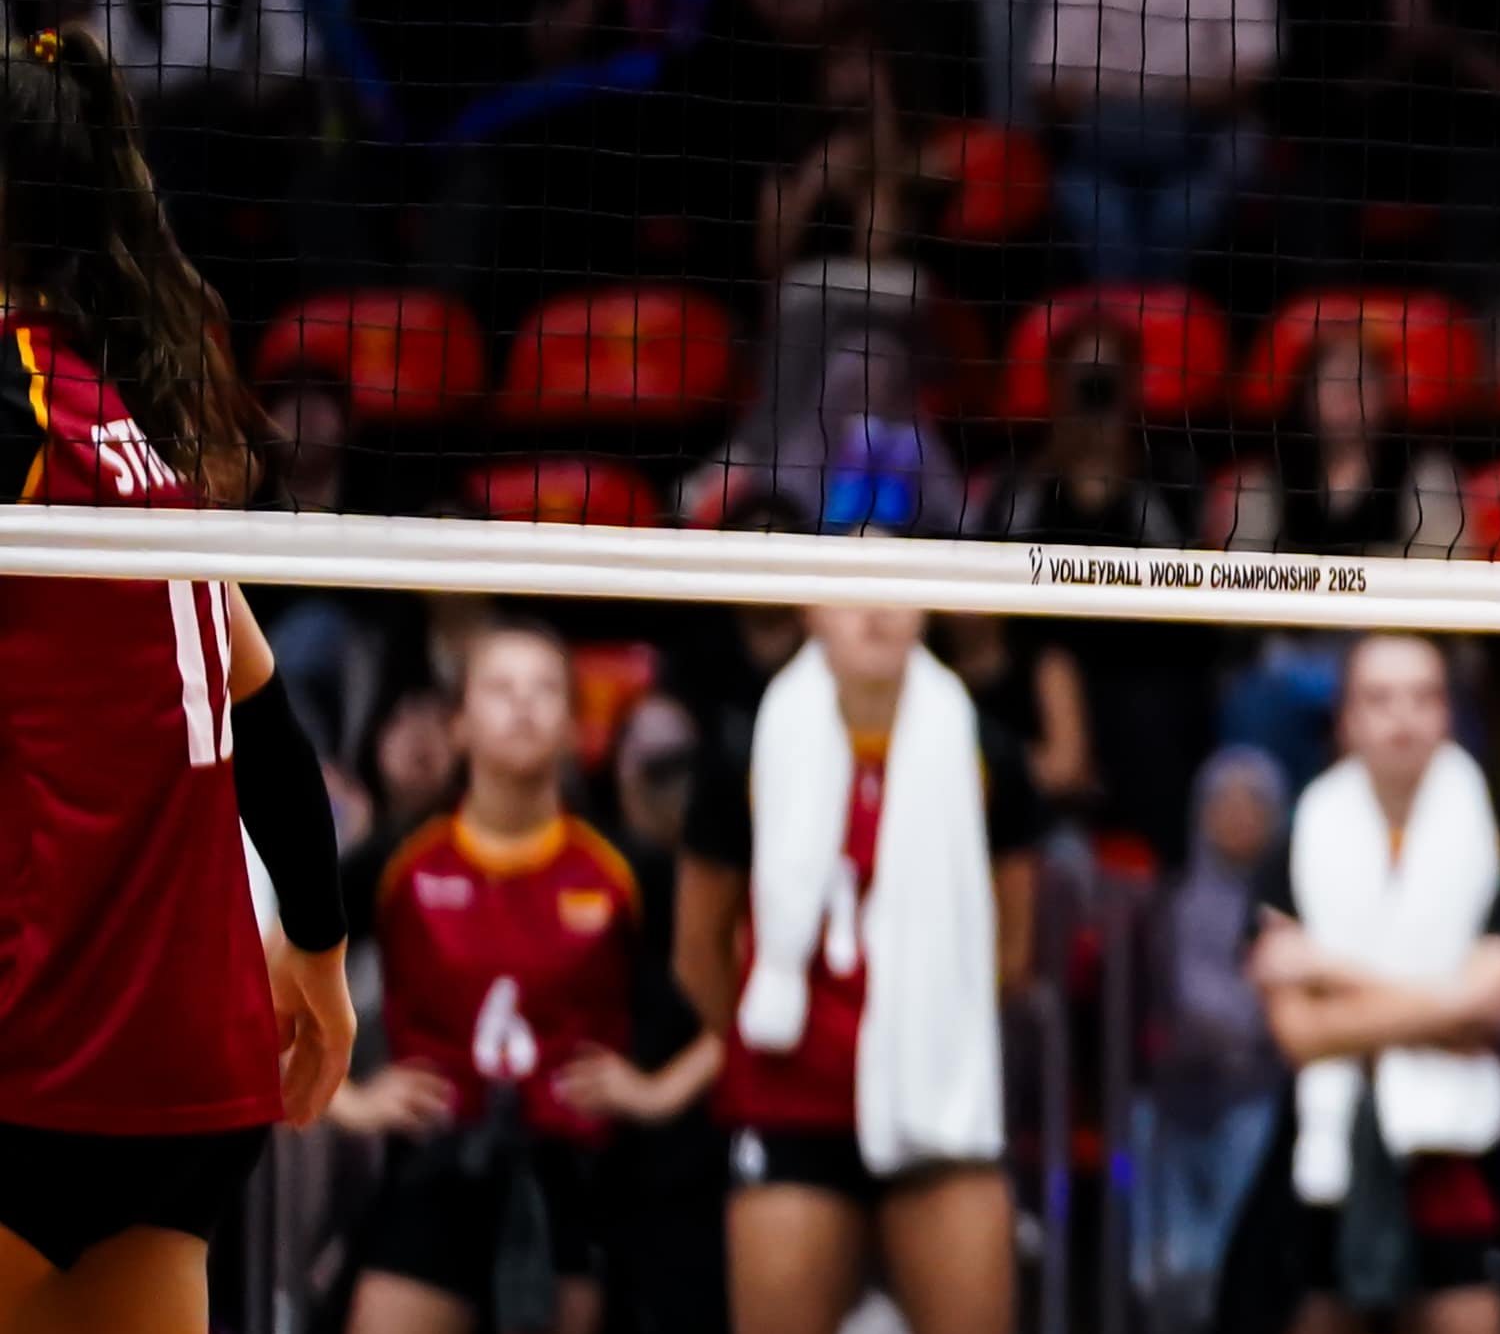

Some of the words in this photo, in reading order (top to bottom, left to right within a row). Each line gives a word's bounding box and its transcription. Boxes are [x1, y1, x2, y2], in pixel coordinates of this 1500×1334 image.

[1049, 557, 1142, 586] VOLLEYBALL
[1149, 562, 1203, 588] WORLD
[1211, 564, 1321, 591] CHAMPIONSHIP
[1328, 567, 1367, 593] 2025
[472, 977, 538, 1079] 6
